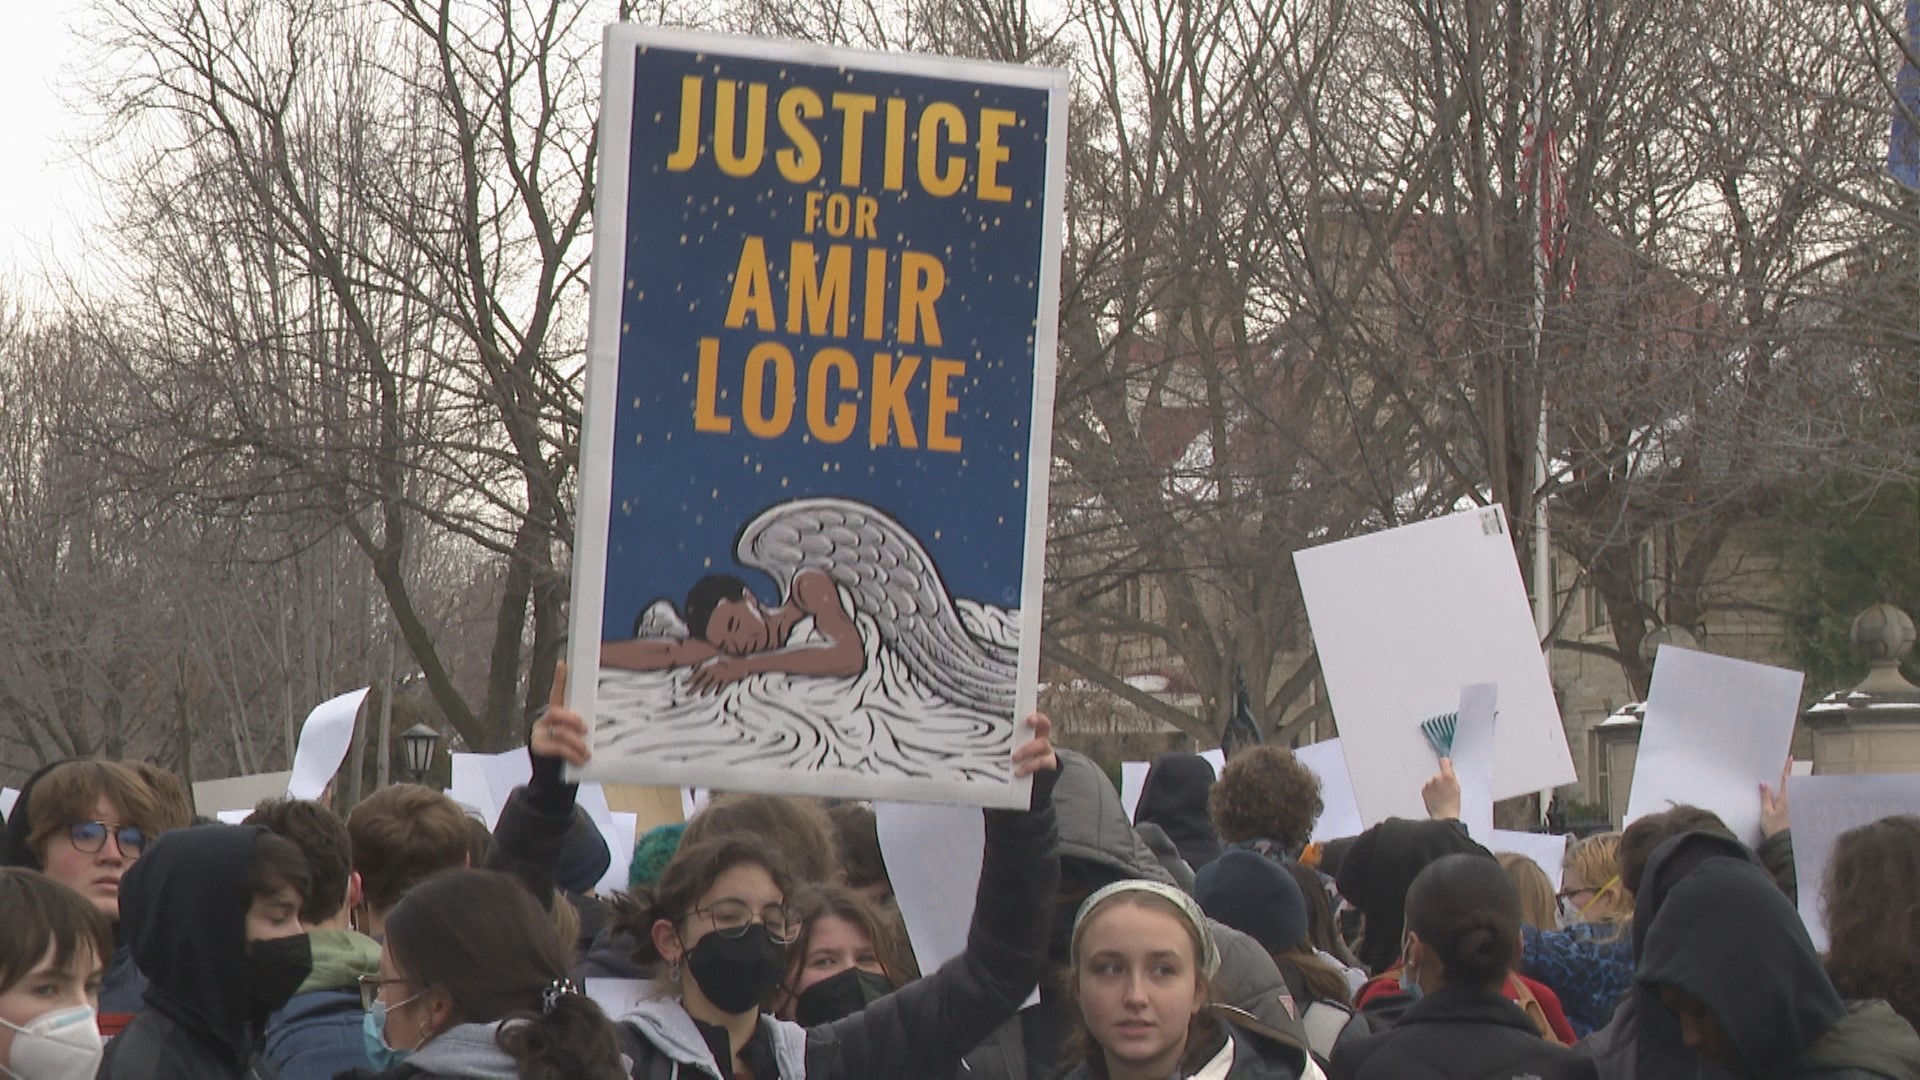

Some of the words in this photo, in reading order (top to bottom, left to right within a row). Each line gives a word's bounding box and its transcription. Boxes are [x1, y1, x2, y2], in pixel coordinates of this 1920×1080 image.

[667, 75, 1017, 202] JUSTICE
[804, 191, 879, 239] FOR
[724, 236, 947, 347] AMIR
[694, 338, 967, 453] LOCKE
